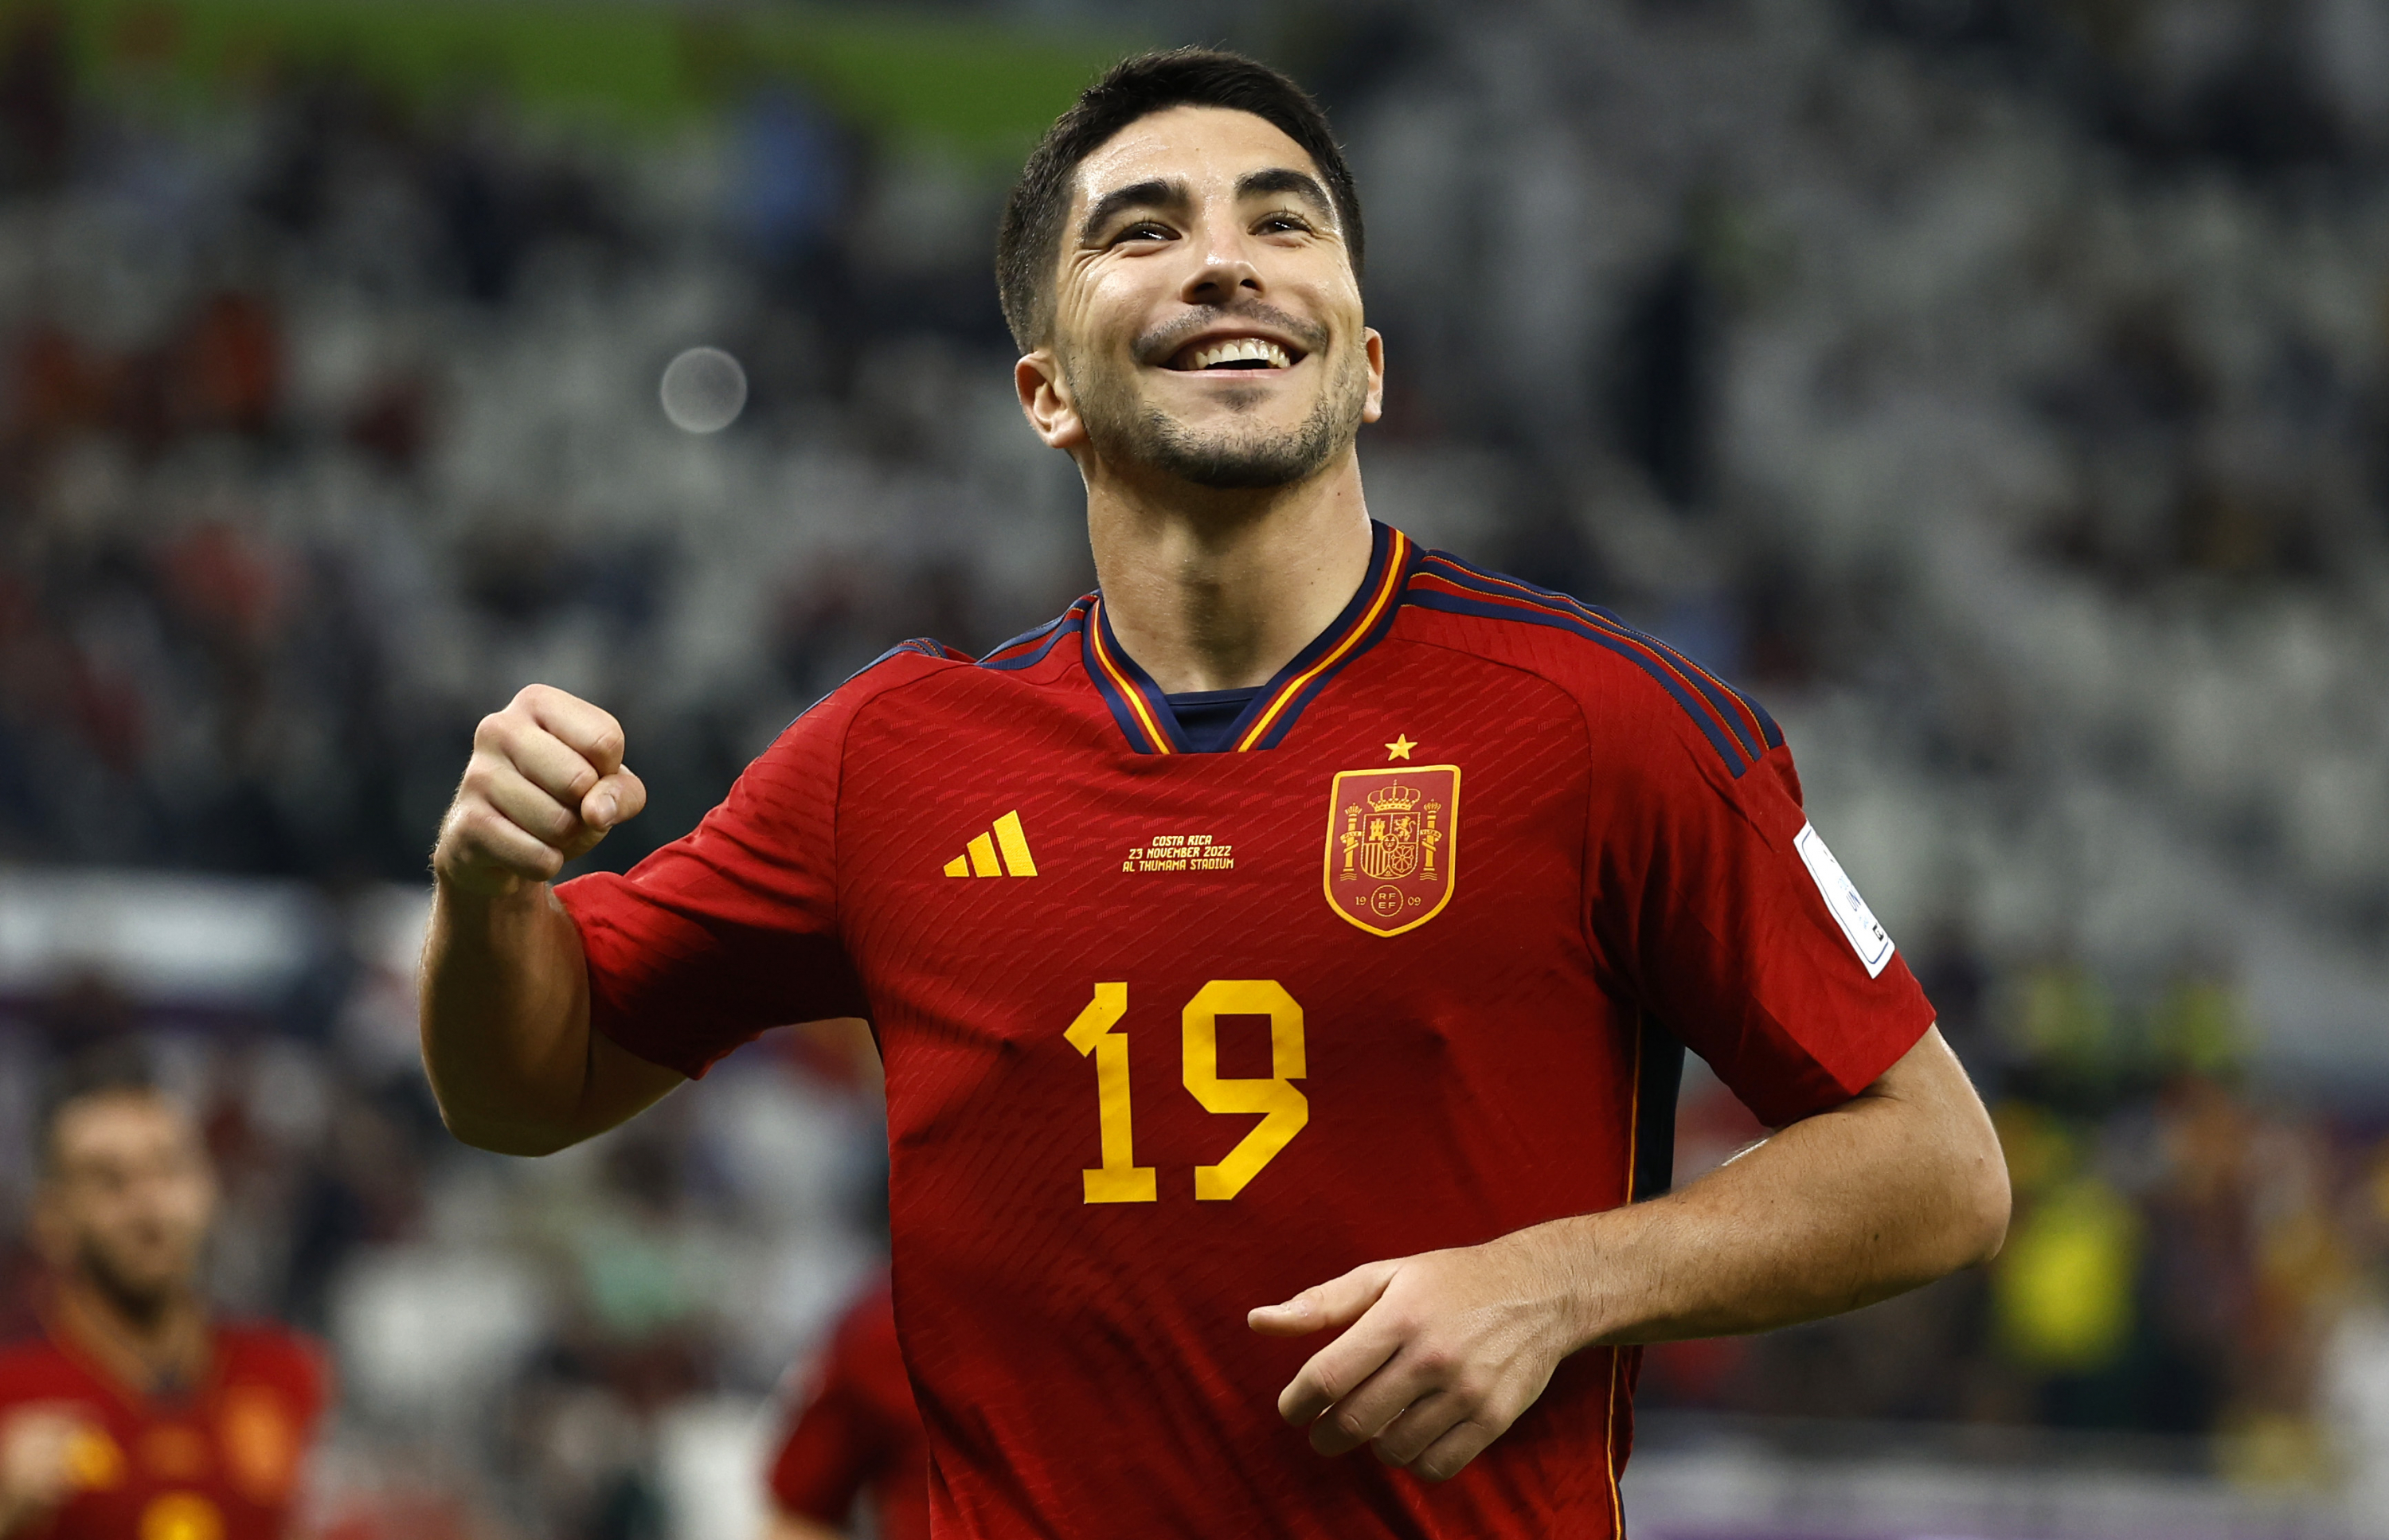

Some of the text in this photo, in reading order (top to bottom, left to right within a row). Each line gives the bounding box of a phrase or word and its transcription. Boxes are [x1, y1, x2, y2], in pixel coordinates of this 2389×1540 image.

[1152, 835, 1212, 846] COSTA RICA
[1128, 846, 1232, 859] 23 NOVEMBER 2022
[1123, 858, 1234, 872] AL THUMAMA STADIUM
[1355, 896, 1367, 905] 19
[1407, 896, 1421, 906] 09
[1063, 979, 1309, 1204] 19
